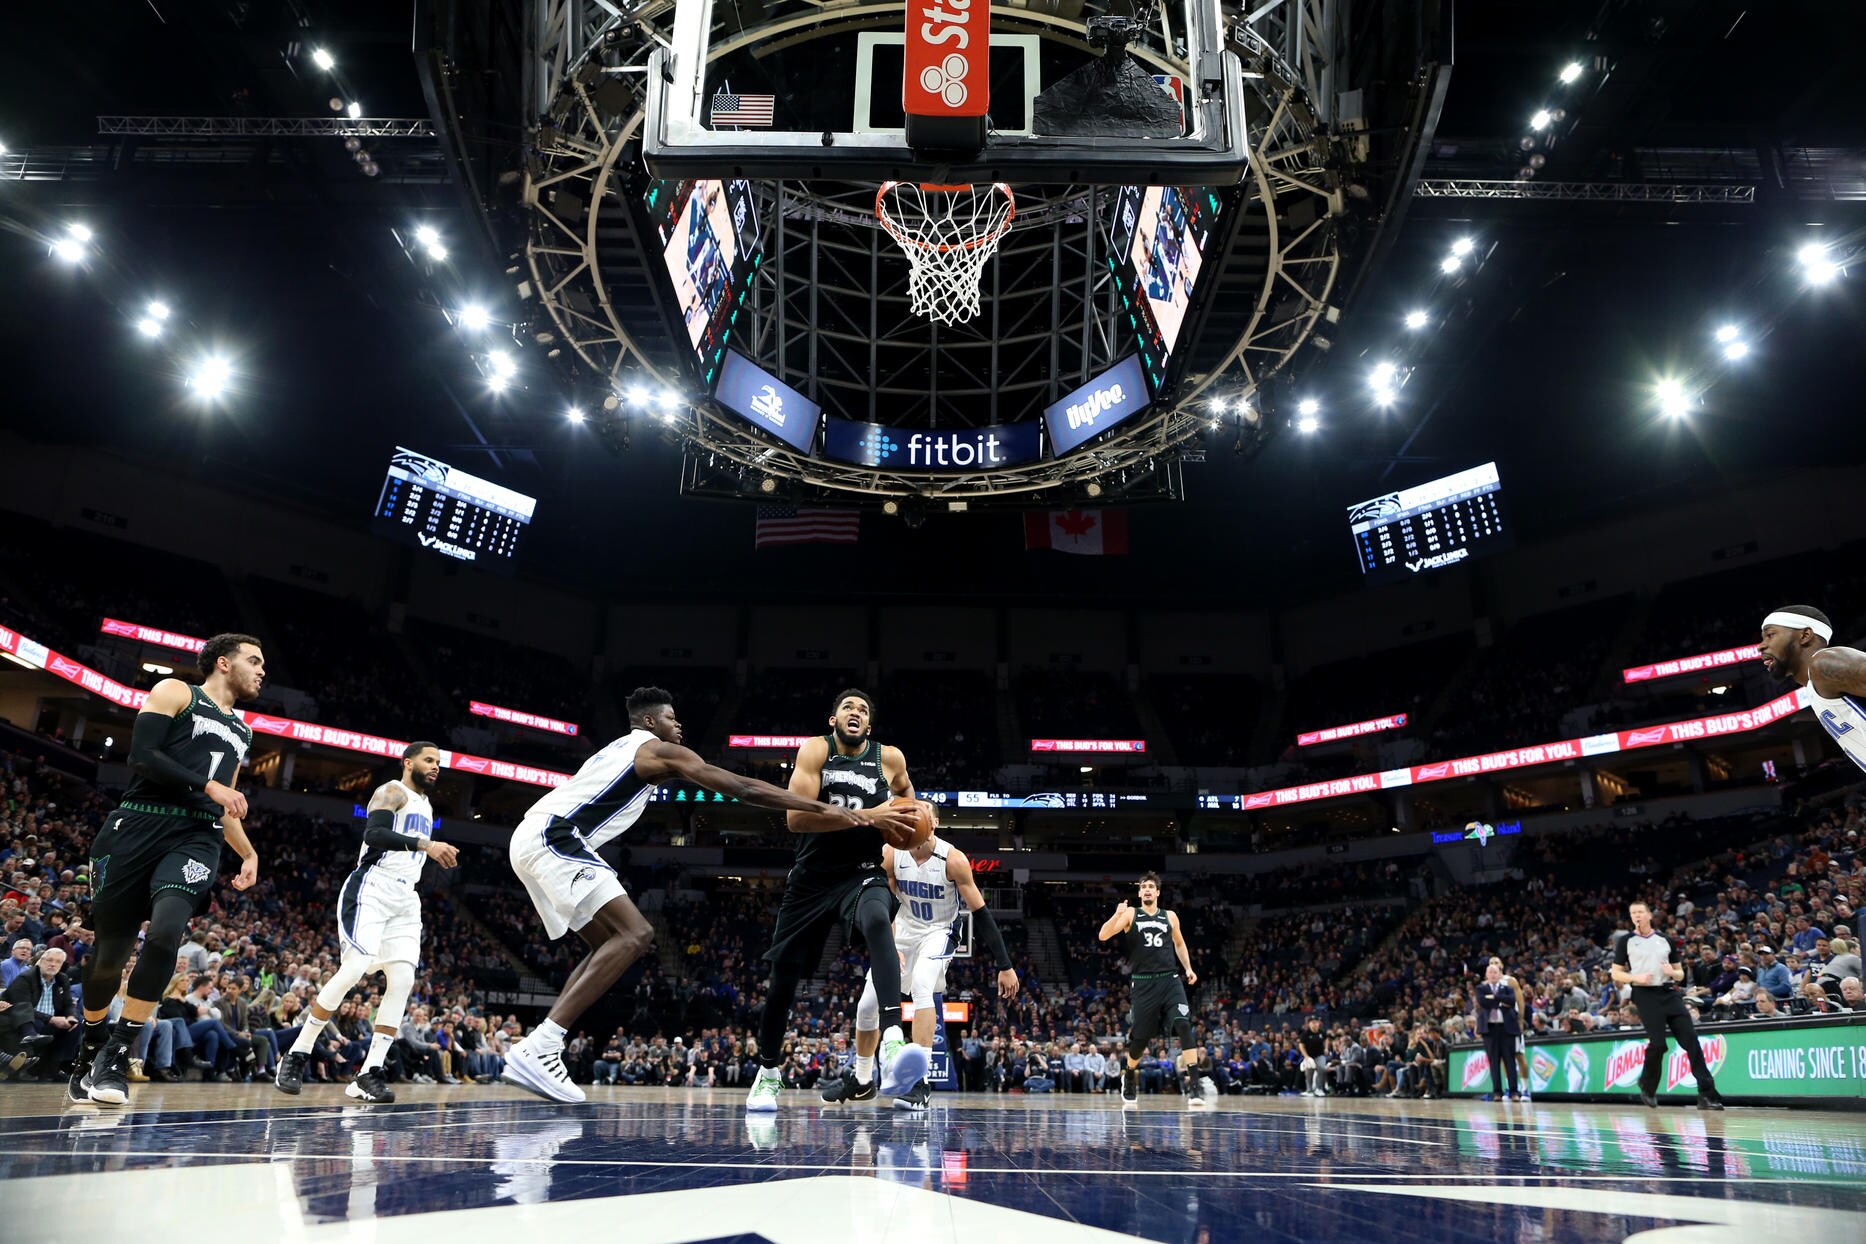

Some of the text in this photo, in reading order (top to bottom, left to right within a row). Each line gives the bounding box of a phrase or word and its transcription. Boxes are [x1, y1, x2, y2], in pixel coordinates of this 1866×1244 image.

[138, 628, 161, 642] THIS
[1654, 662, 1680, 675] THIS
[1680, 656, 1712, 671] BUD'S
[1713, 651, 1735, 664] FOR
[81, 669, 103, 691] THIS
[102, 680, 133, 704] BUD'S
[494, 708, 510, 720] THIS
[534, 716, 549, 728] FOR
[1669, 721, 1704, 739] THIS
[1705, 713, 1752, 734] BUD'S
[1752, 704, 1771, 726] FOR
[1772, 697, 1795, 716] YOU.
[292, 723, 322, 741] THIS
[323, 729, 361, 749] BUD'S
[362, 737, 387, 753] FOR
[754, 737, 771, 746] THIS
[1320, 729, 1336, 740] THIS
[1360, 722, 1376, 732] FOR
[1056, 741, 1073, 750] THIS
[1100, 742, 1113, 750] FOR
[1452, 759, 1480, 775] THIS
[1481, 752, 1518, 769] BUD'S
[1519, 747, 1545, 763] FOR
[1545, 742, 1576, 759] YOU.
[491, 763, 514, 778] THIS
[516, 768, 546, 784] BUD'S
[966, 794, 979, 803] 55
[1275, 789, 1297, 802] THIS
[1299, 784, 1329, 799] BUD'S
[1330, 780, 1350, 794] FOR
[1351, 776, 1377, 790] YOU.
[896, 880, 945, 899] MAGIC
[910, 900, 933, 921] 00
[1143, 932, 1163, 947] 36
[1668, 1038, 1721, 1090] LIBAN
[1748, 1048, 1805, 1078] CLEANING
[1808, 1047, 1846, 1078] SINCE
